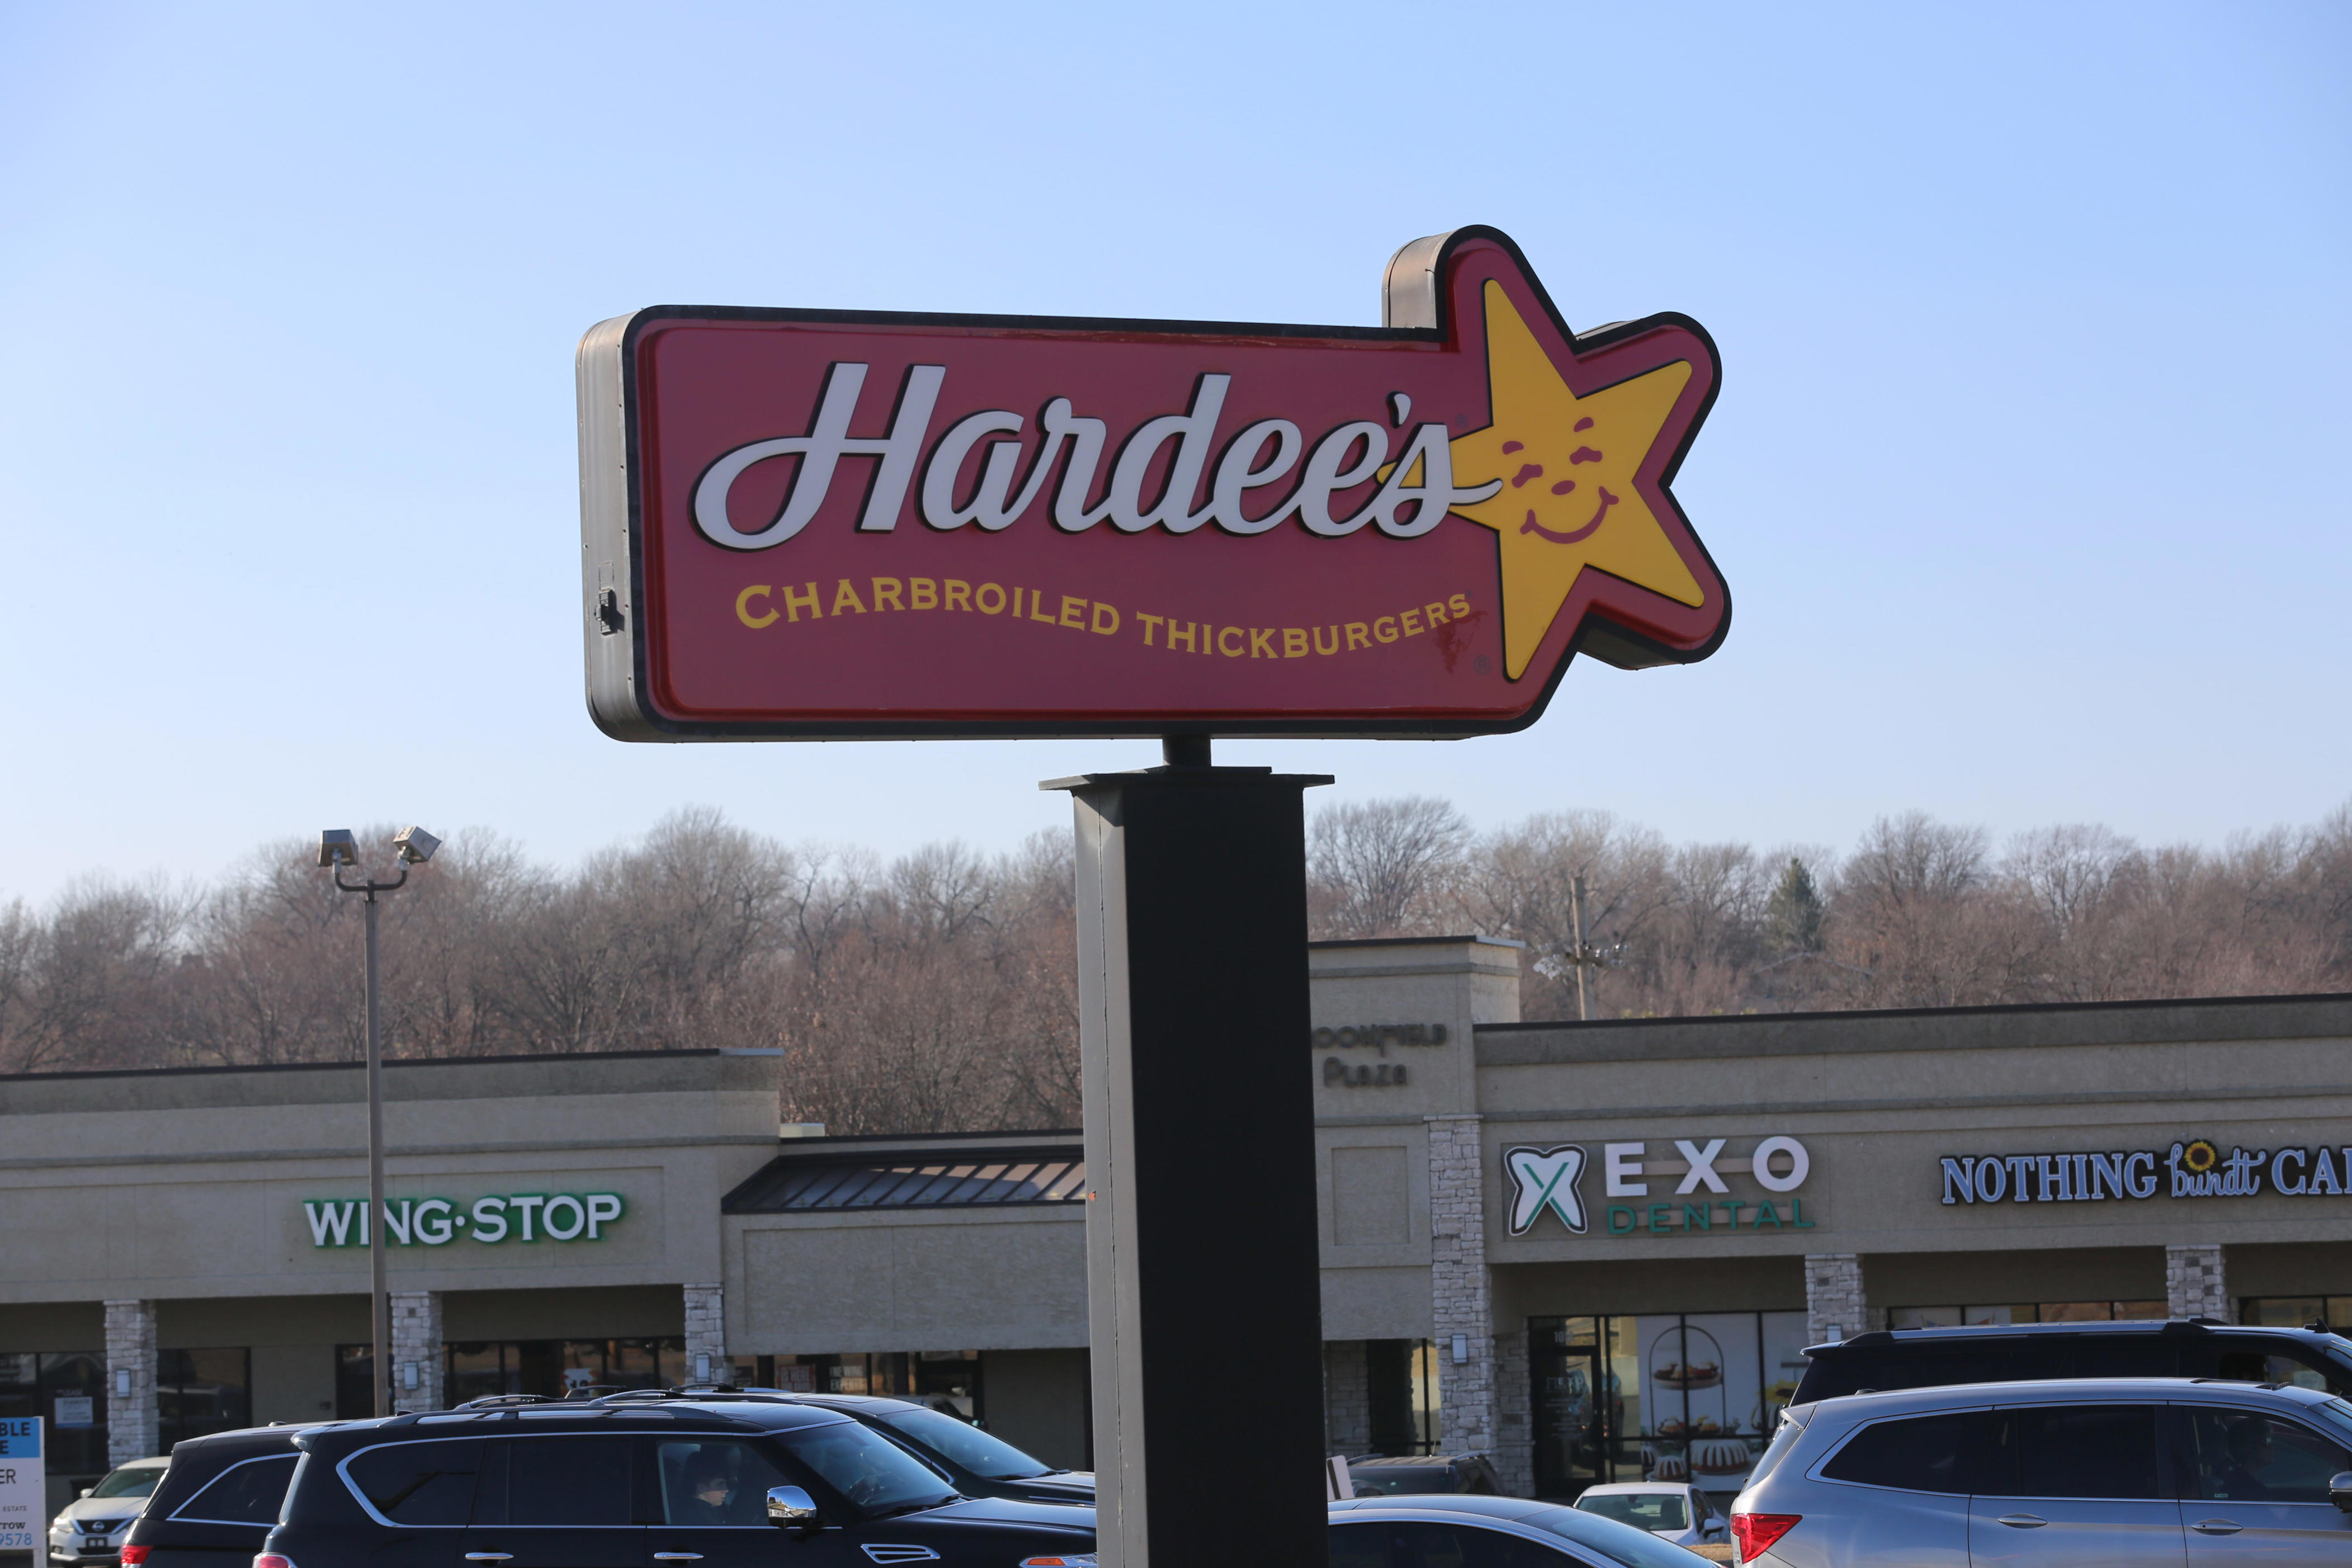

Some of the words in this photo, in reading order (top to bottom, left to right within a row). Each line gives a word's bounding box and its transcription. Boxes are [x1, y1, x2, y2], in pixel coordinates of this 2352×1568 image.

[692, 361, 1503, 551] Hardee's
[735, 577, 1120, 635] CHARBROILED
[1136, 593, 1471, 659] THICKBURGERS
[1604, 1136, 1810, 1197] EXO
[1940, 1152, 2157, 1204] NOTHING
[2164, 1142, 2266, 1198] bundt
[1608, 1198, 1815, 1234] DENTAL
